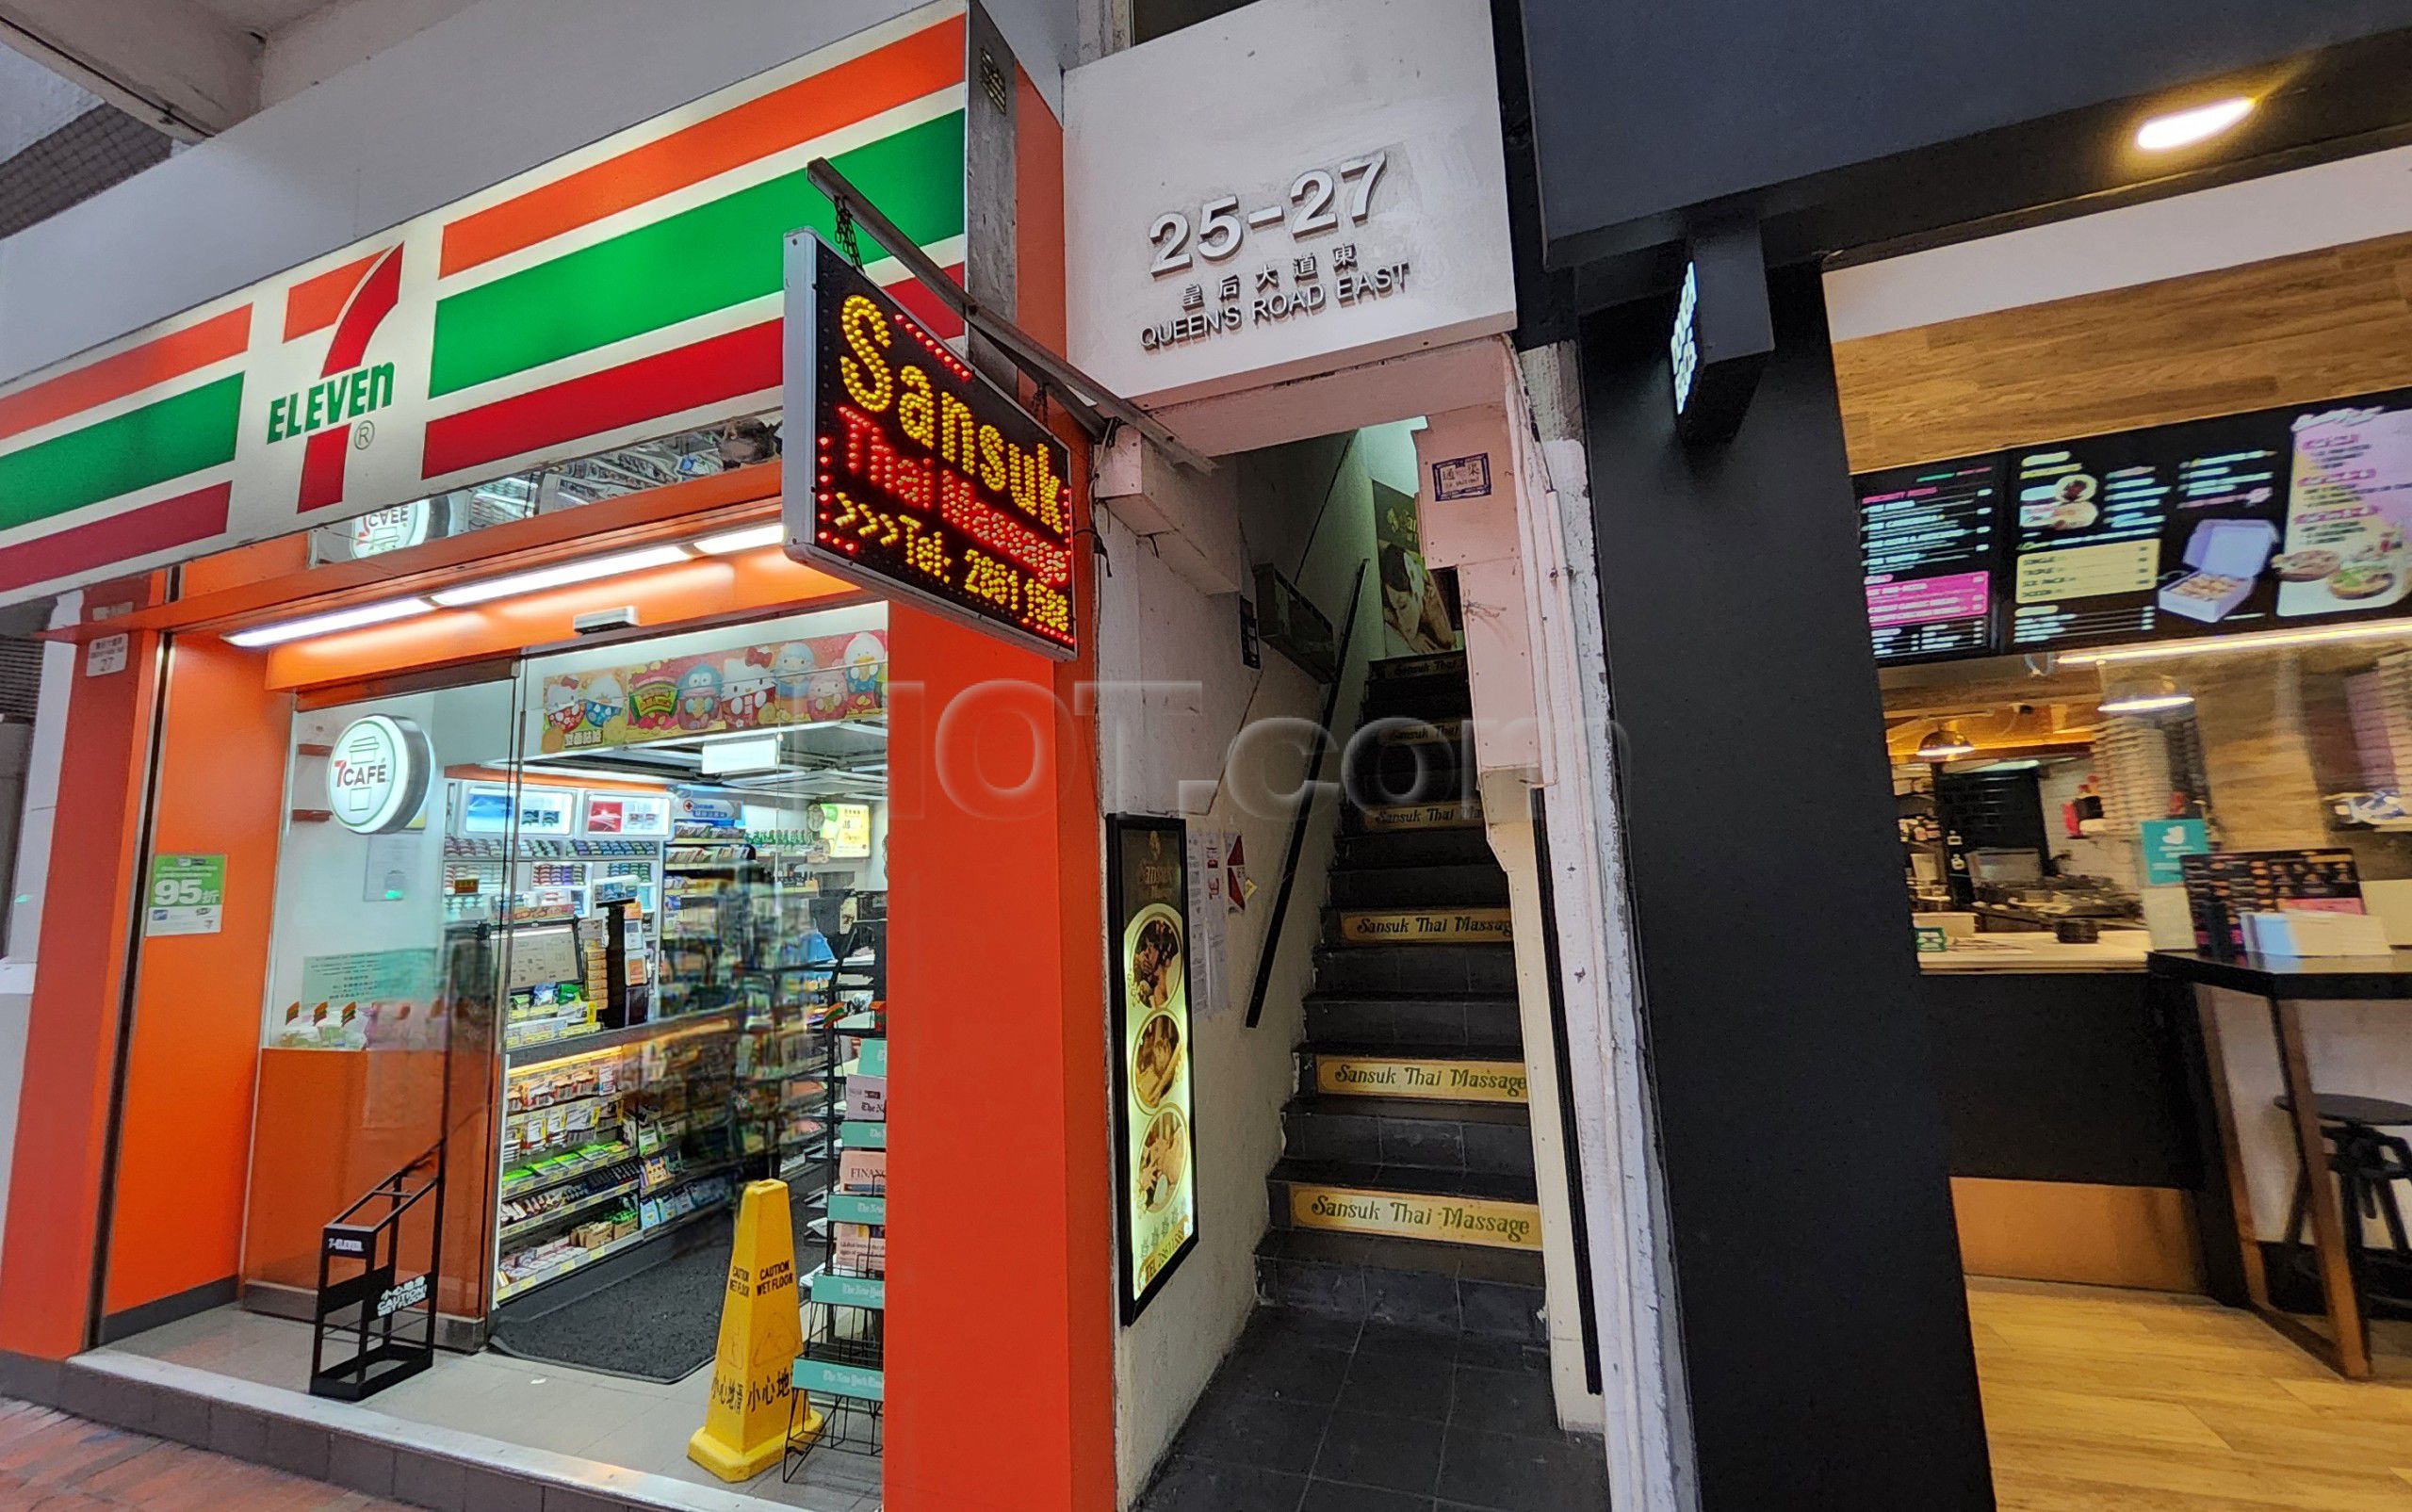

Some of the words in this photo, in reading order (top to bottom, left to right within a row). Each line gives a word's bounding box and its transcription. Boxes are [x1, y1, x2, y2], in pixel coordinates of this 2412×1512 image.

[1149, 151, 1388, 280] 25-27
[1182, 242, 1358, 312] 皇后大道東
[1252, 285, 1325, 326] ROAD
[1336, 261, 1410, 308] EAST
[297, 241, 405, 513] 7
[839, 294, 1064, 534] Sansuk
[839, 406, 933, 510] Thai
[942, 470, 1067, 583] Massage
[899, 514, 951, 583] Tel:
[1376, 806, 1421, 823] Sansuk
[1426, 804, 1454, 821] Thai
[1357, 917, 1409, 935] Sansuk
[1416, 916, 1447, 933] Thai
[1455, 916, 1511, 935] Massag
[1335, 1065, 1396, 1084] Sansuk
[1404, 1066, 1442, 1086] Thai
[1450, 1068, 1527, 1097] Massage
[1311, 1195, 1380, 1220] Sansuk
[1390, 1201, 1433, 1225] Thai
[1442, 1207, 1530, 1243] Massage
[757, 1280, 772, 1296] WET
[759, 1260, 790, 1280] CAUTION
[747, 1366, 792, 1412] 小心地
